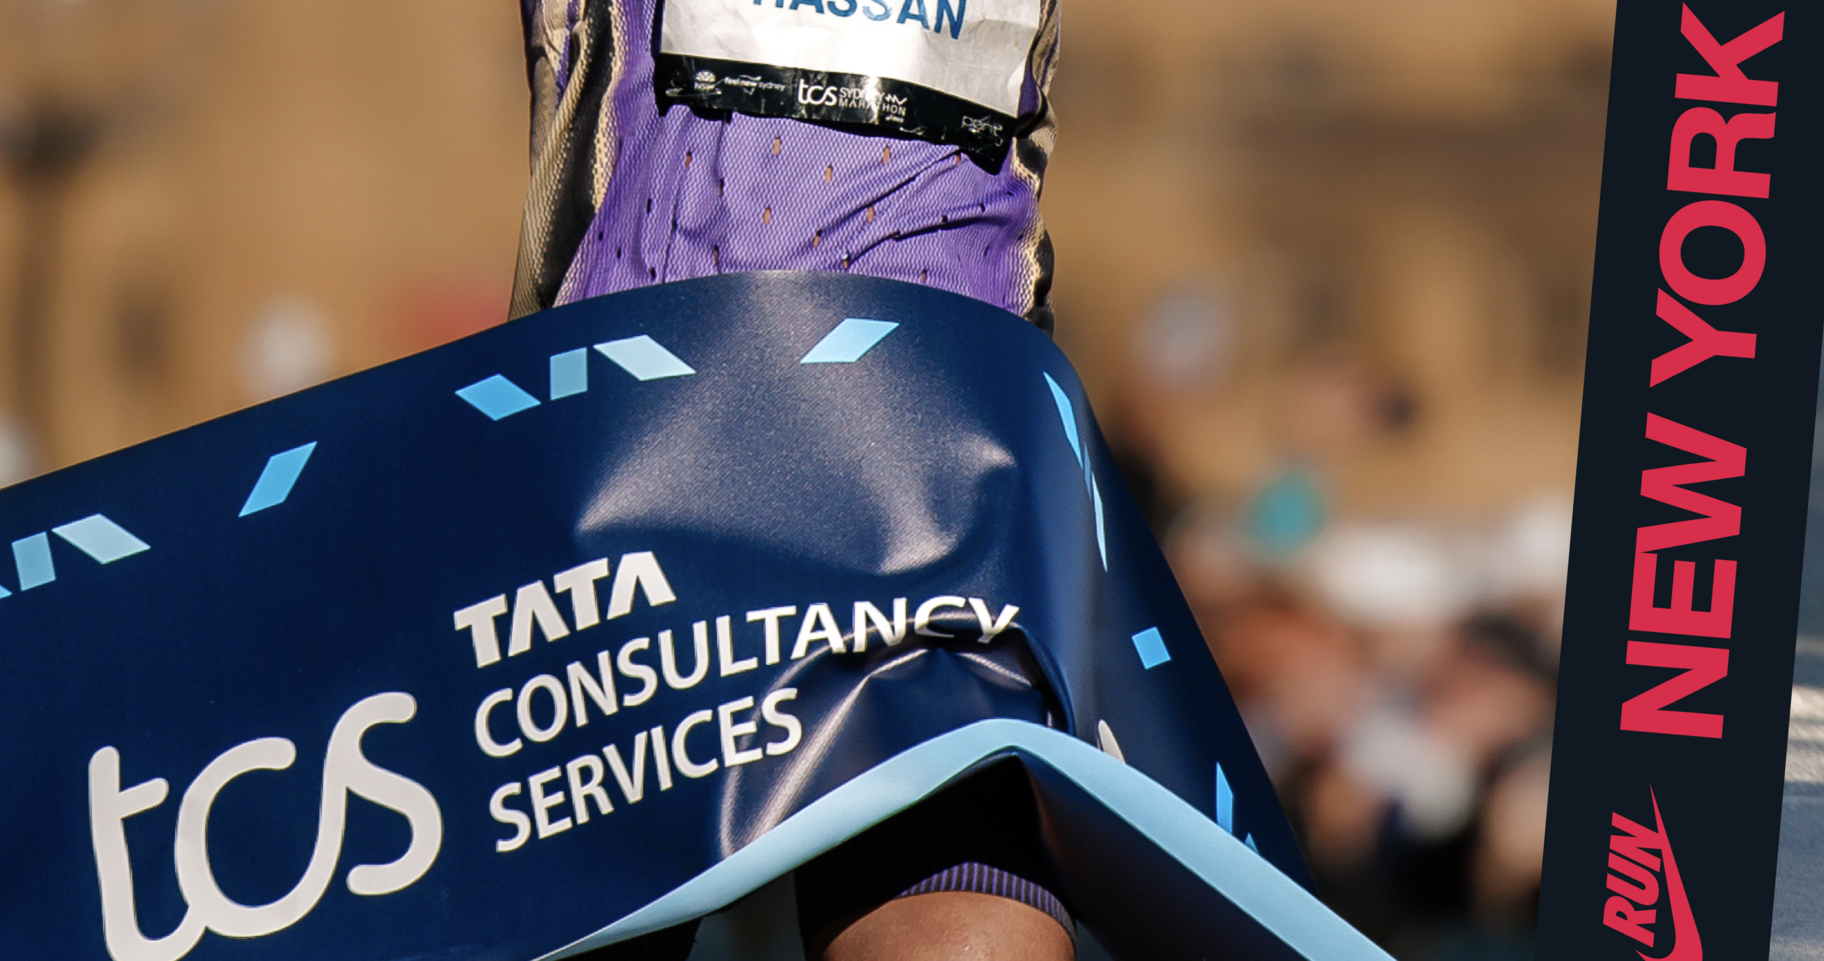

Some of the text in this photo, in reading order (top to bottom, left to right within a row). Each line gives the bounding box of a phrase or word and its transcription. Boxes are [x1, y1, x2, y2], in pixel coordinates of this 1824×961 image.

[798, 78, 837, 106] tcs
[839, 86, 885, 101] SYDY
[453, 551, 677, 668] TATA
[475, 595, 1019, 758] CONSULTANCY
[88, 692, 442, 961] tcs
[489, 688, 802, 853] SERVICES
